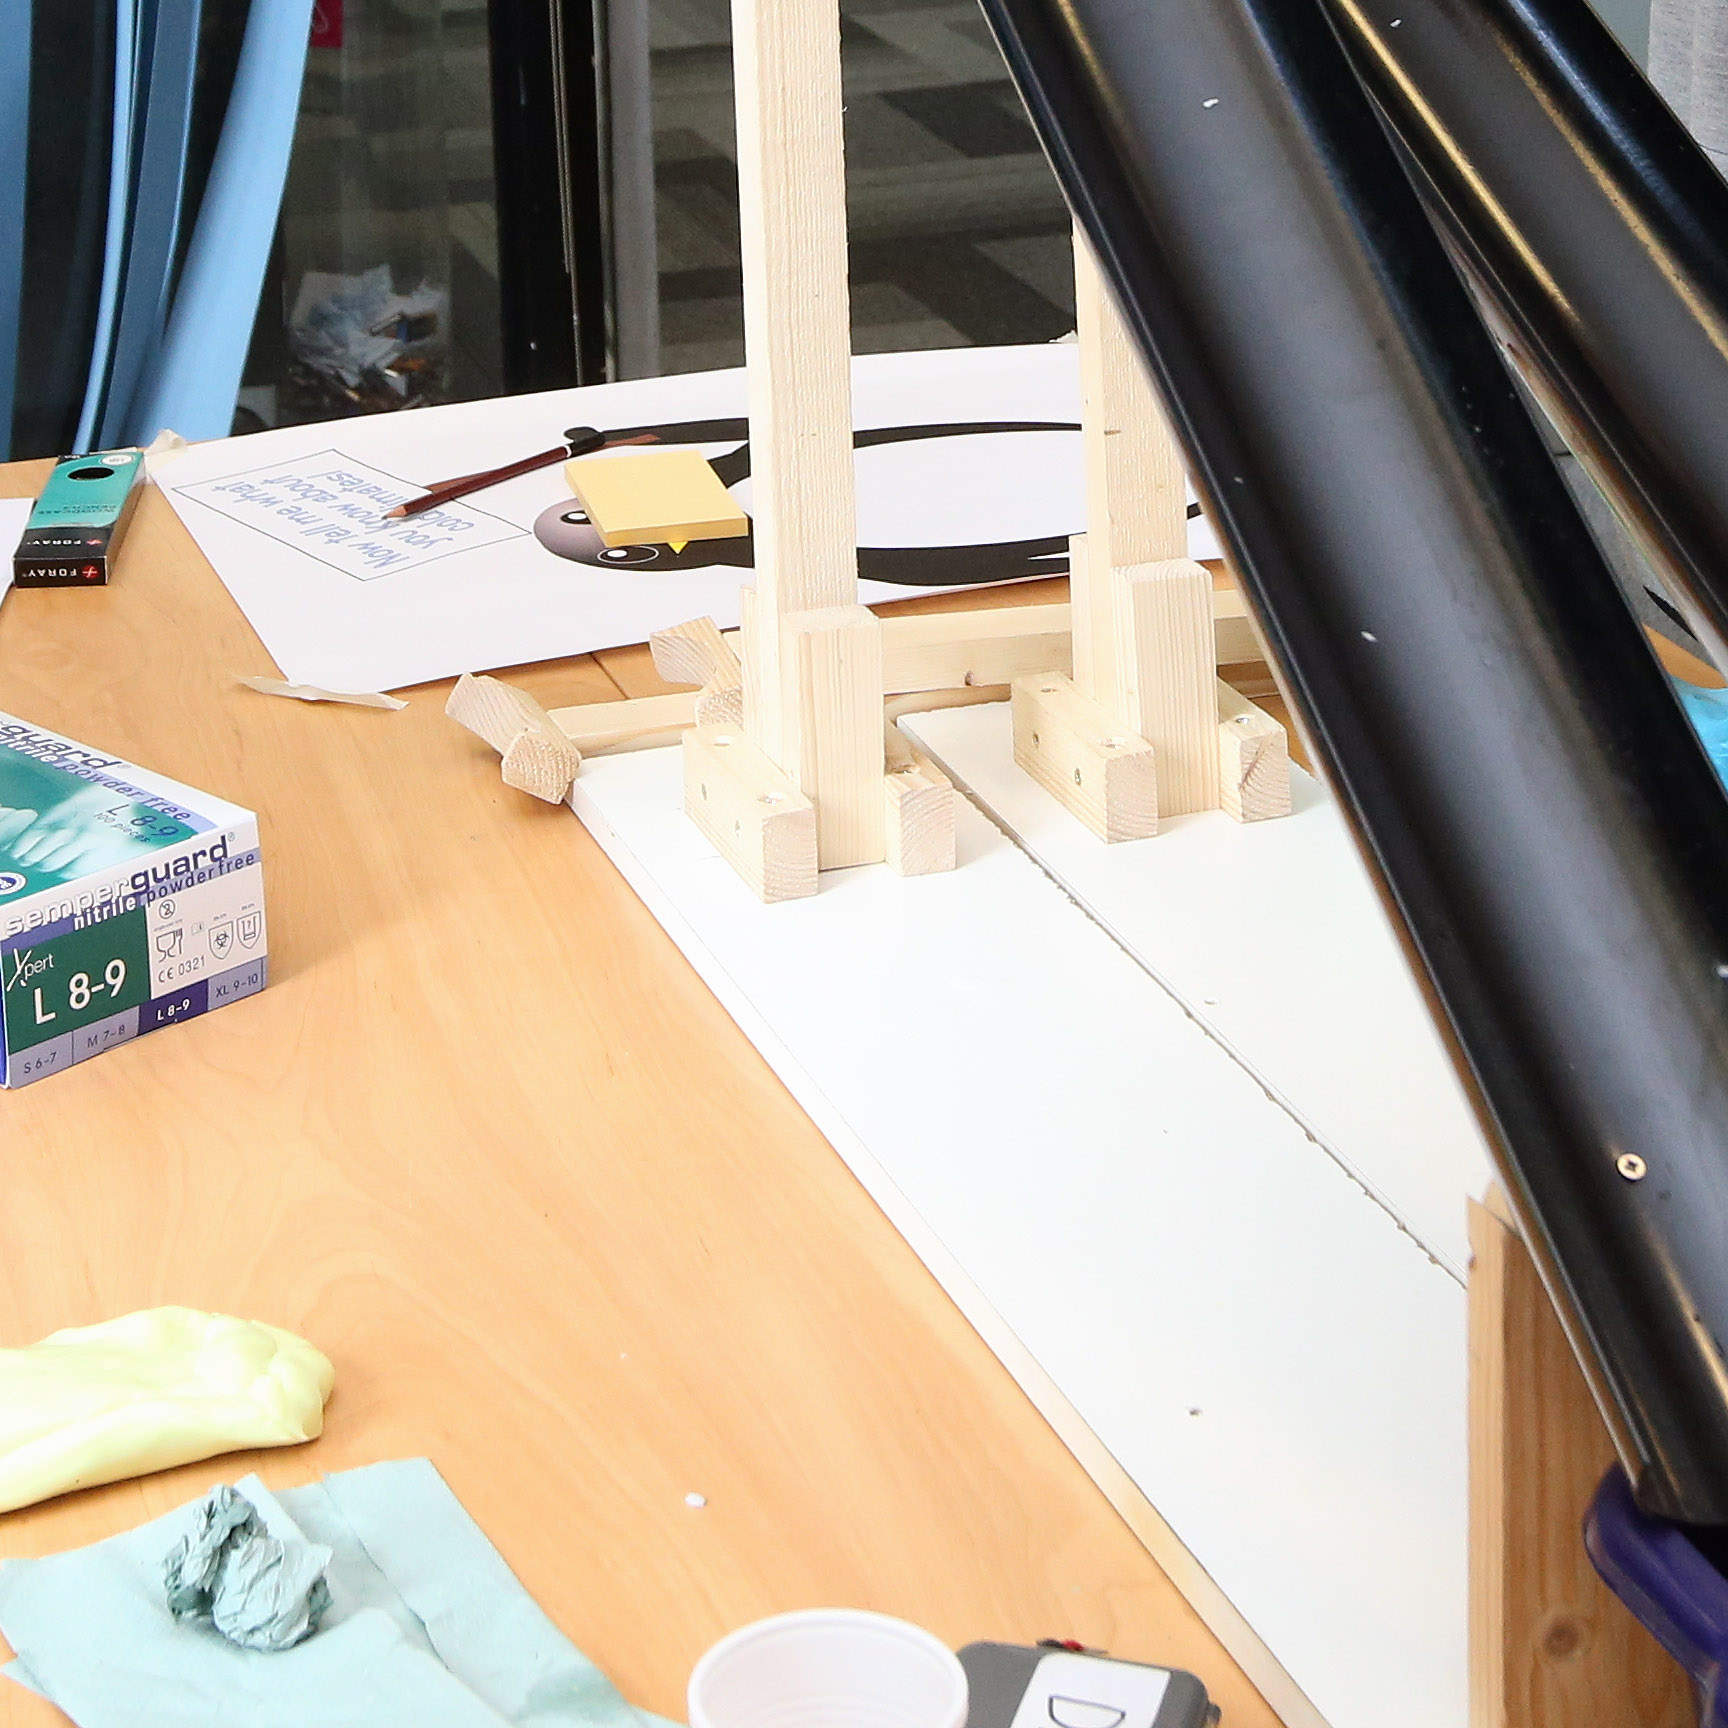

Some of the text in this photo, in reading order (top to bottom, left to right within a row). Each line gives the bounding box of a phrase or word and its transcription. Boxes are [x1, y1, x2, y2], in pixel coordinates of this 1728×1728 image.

[307, 469, 409, 512] limates!
[212, 481, 410, 569] Now tell me what
[259, 474, 454, 550] you know about
[54, 758, 145, 800] powder
[140, 796, 192, 821] free
[93, 811, 152, 844] 100 pieces
[106, 802, 179, 839] L 8-9
[4, 835, 229, 938] semperguard
[73, 892, 137, 932] nitrile
[178, 954, 206, 976] 0321
[33, 986, 57, 1025] L
[68, 958, 127, 1011] 8-9
[215, 971, 259, 999] XL 9-10
[156, 998, 192, 1022] L 8-9
[86, 1024, 126, 1049] M 7-8
[23, 1051, 58, 1075] S 6-7
